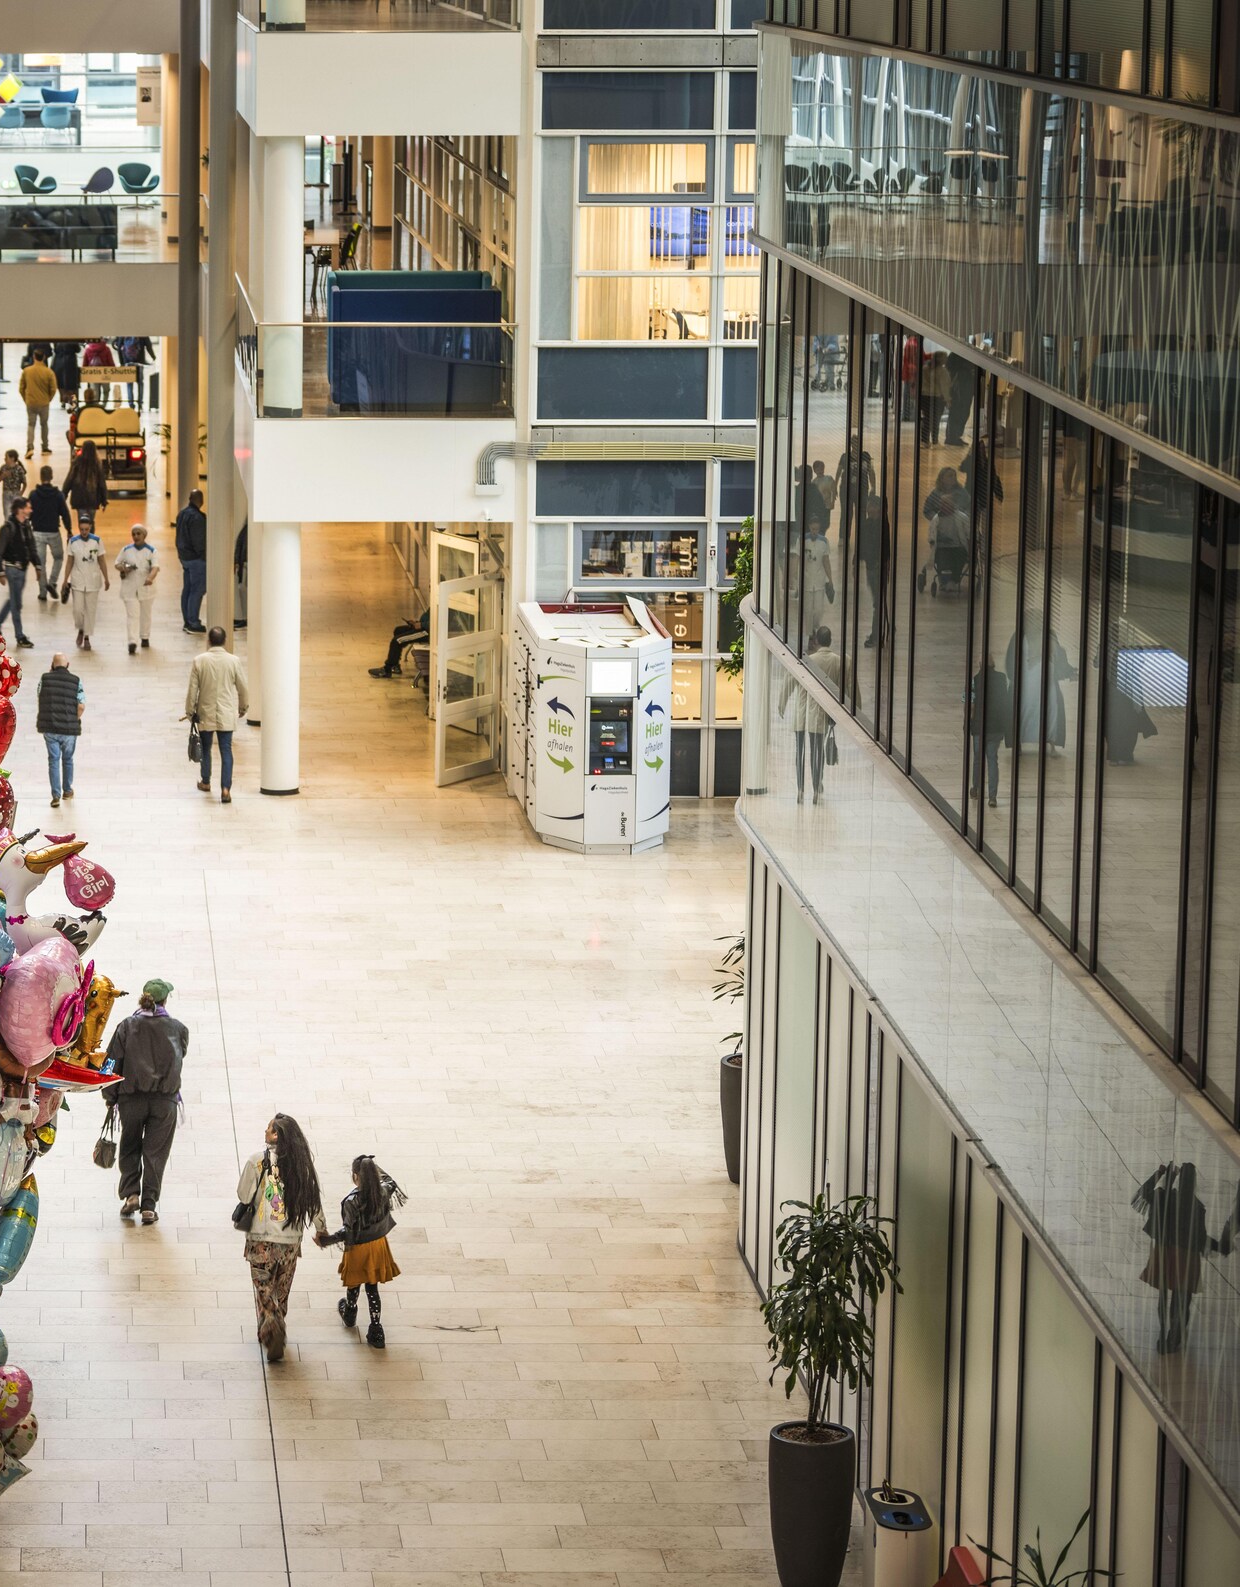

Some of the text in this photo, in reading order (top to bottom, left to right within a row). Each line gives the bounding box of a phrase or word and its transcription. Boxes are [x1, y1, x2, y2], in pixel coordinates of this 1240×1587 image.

[81, 367, 101, 375] Gratis
[548, 718, 573, 737] Hier
[646, 722, 664, 739] Hier
[547, 739, 574, 753] afhalen
[645, 741, 664, 756] afhalen
[79, 876, 109, 899] Girl
